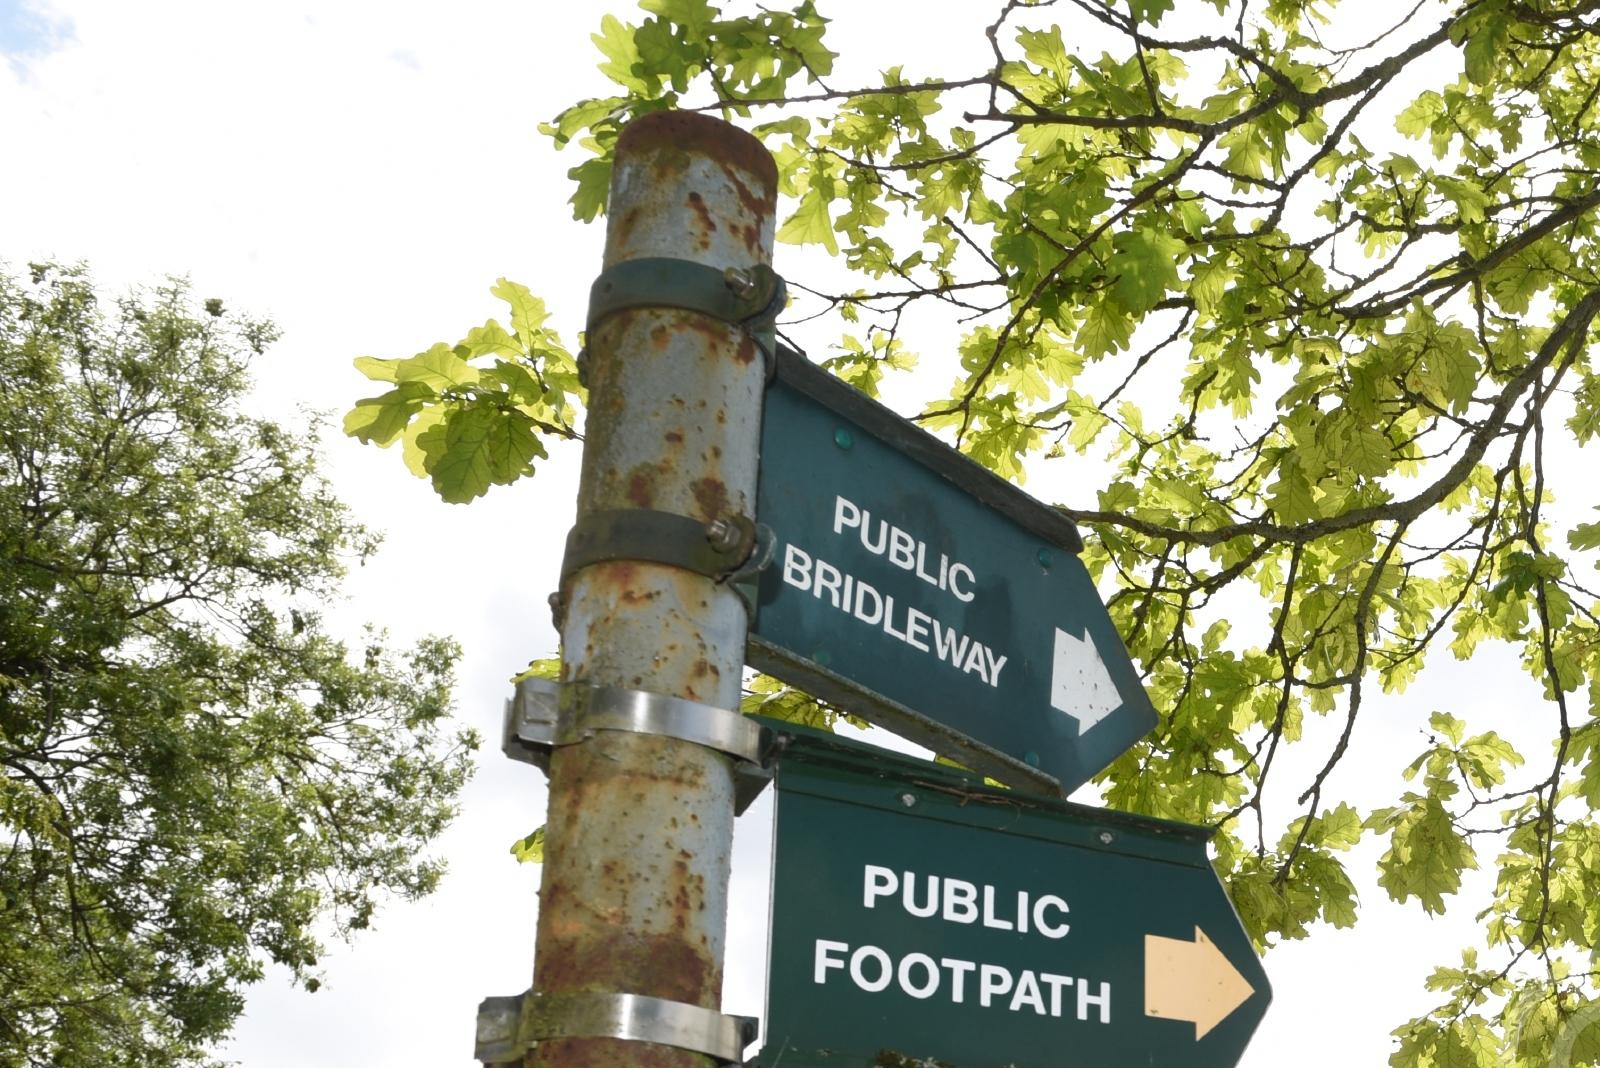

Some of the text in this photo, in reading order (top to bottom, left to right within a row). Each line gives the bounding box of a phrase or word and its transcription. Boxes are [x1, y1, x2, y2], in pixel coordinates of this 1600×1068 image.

[833, 495, 976, 603] PUBLIC
[782, 542, 1008, 688] BRIDLEWAY
[863, 864, 1071, 940] PUBLIC
[813, 938, 1111, 1024] FOOTPATH
